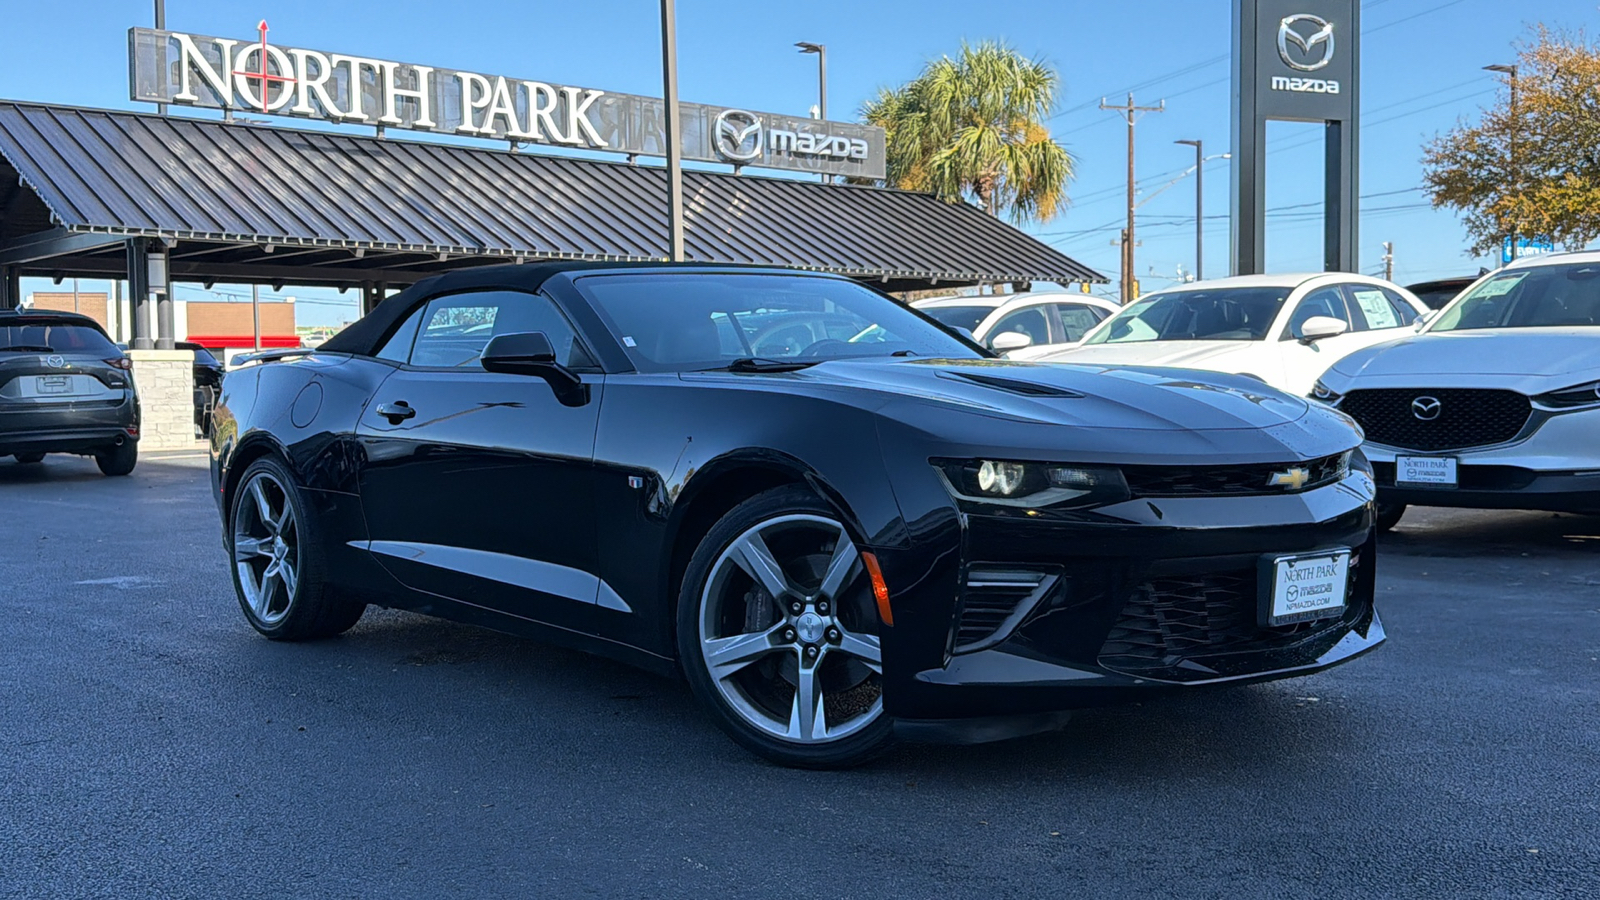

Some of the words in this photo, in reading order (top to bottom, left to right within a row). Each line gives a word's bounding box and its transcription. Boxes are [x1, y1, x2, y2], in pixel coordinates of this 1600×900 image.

[171, 32, 437, 128] NORTH
[455, 70, 609, 147] PARK
[1272, 76, 1340, 94] mazda
[770, 128, 869, 160] mazda
[1404, 460, 1428, 469] NORTH
[1430, 461, 1449, 469] PARK
[1284, 566, 1315, 583] NORTH
[1316, 564, 1338, 578] PARK
[1300, 583, 1333, 597] mazda
[1286, 597, 1331, 611] NPMAZDA.COM
